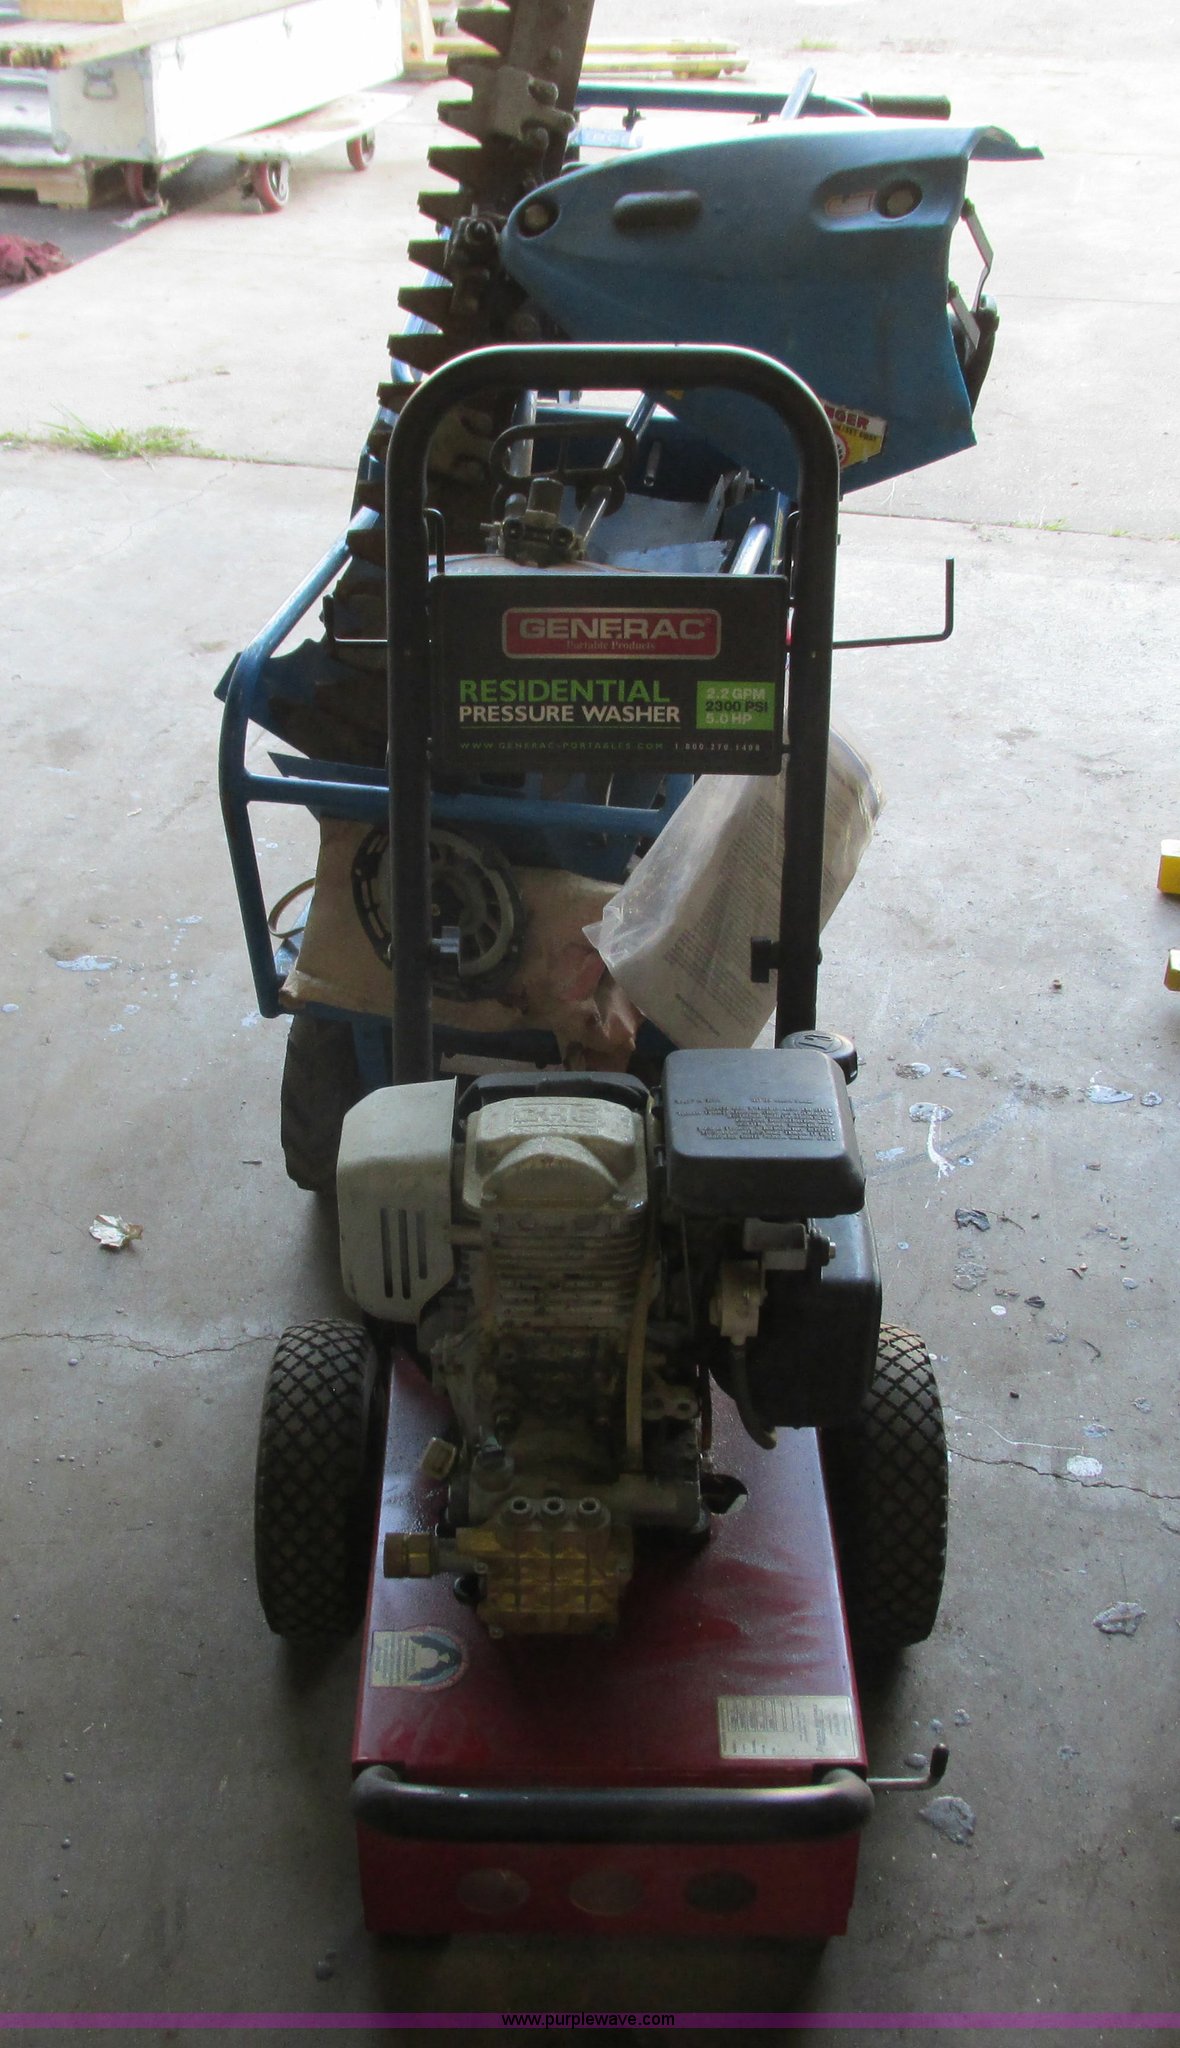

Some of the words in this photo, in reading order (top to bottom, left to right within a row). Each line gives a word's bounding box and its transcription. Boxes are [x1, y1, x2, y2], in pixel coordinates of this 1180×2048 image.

[519, 618, 706, 640] GENERAC
[565, 640, 609, 650] Portable
[611, 640, 656, 651] Products
[459, 679, 670, 703] RESIDENTIAL
[706, 687, 730, 700] 2.2
[732, 687, 766, 700] GPM
[705, 700, 741, 712] 2300
[745, 700, 769, 713] PSI
[459, 705, 574, 723] PRESSURE
[581, 705, 681, 723] WASHER
[705, 712, 729, 724] 5.0
[731, 713, 753, 725] HP
